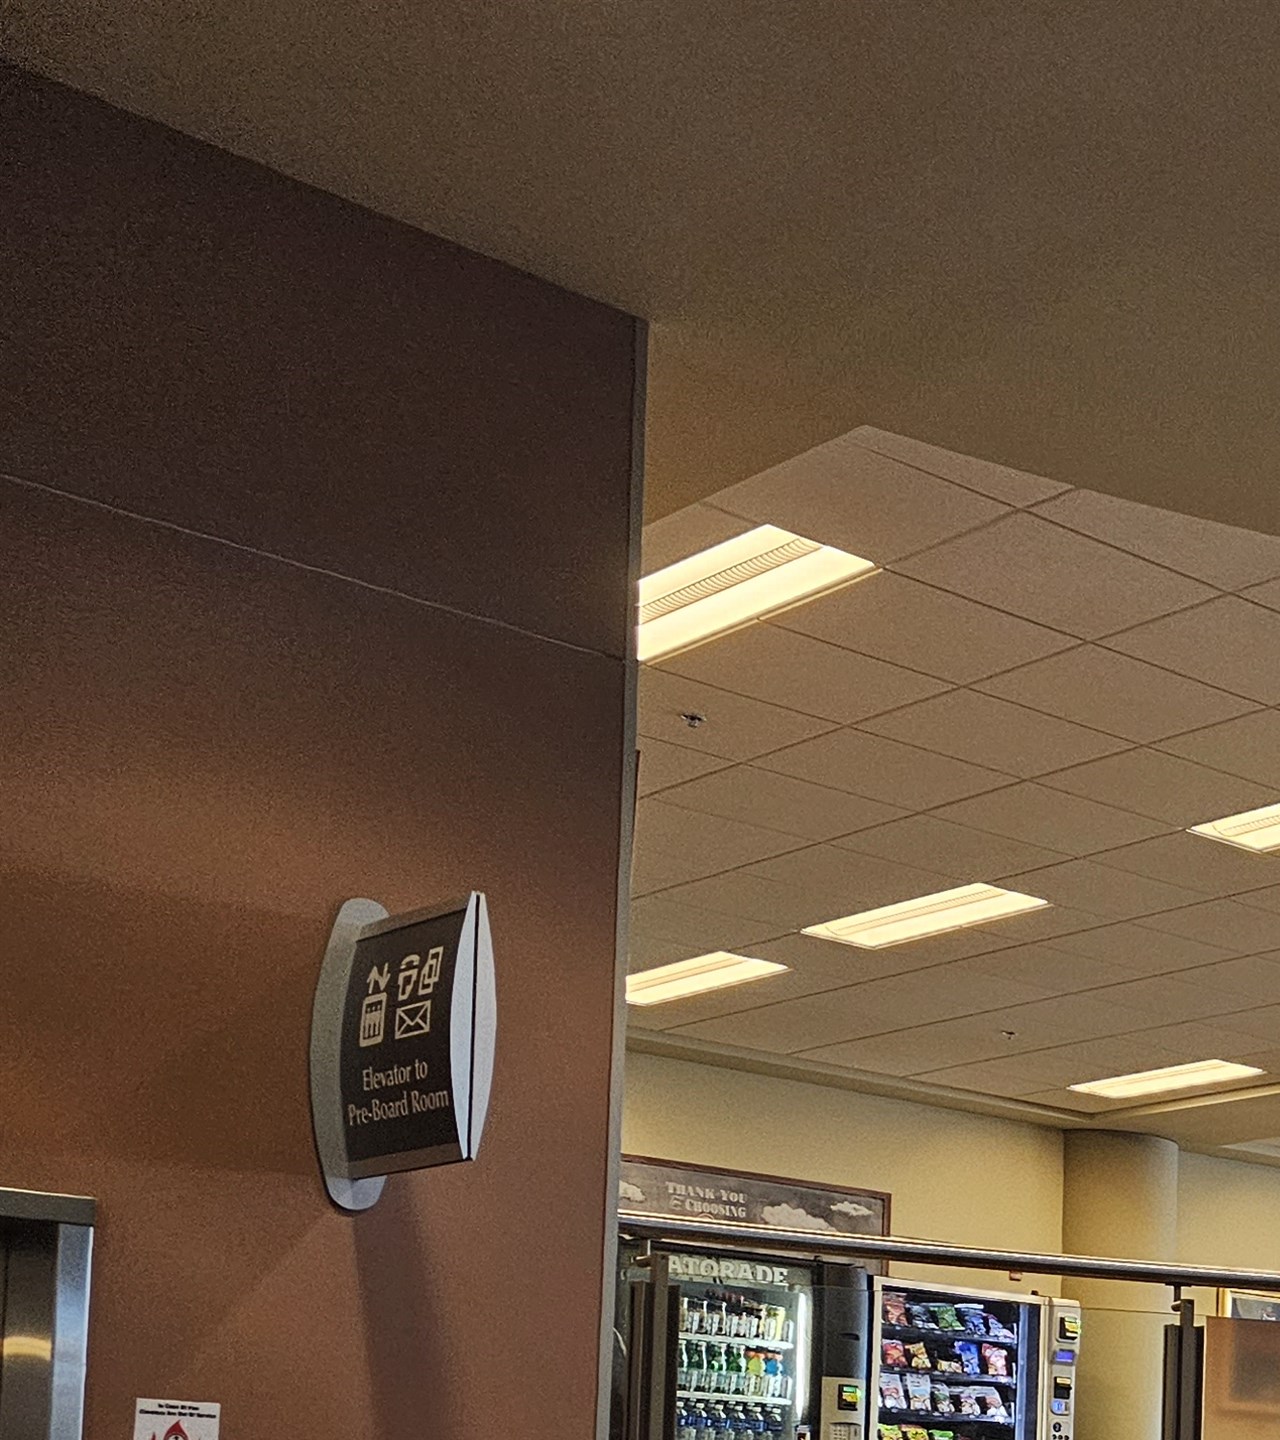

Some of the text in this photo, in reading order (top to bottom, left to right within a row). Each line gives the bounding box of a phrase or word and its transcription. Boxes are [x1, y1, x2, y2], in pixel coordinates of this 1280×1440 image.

[362, 1058, 428, 1091] Elevator to
[347, 1090, 449, 1126] Pre-Board Room
[665, 1181, 748, 1204] THANK YOU
[684, 1199, 747, 1218] CHOOSING
[668, 1254, 789, 1286] ATORADE
